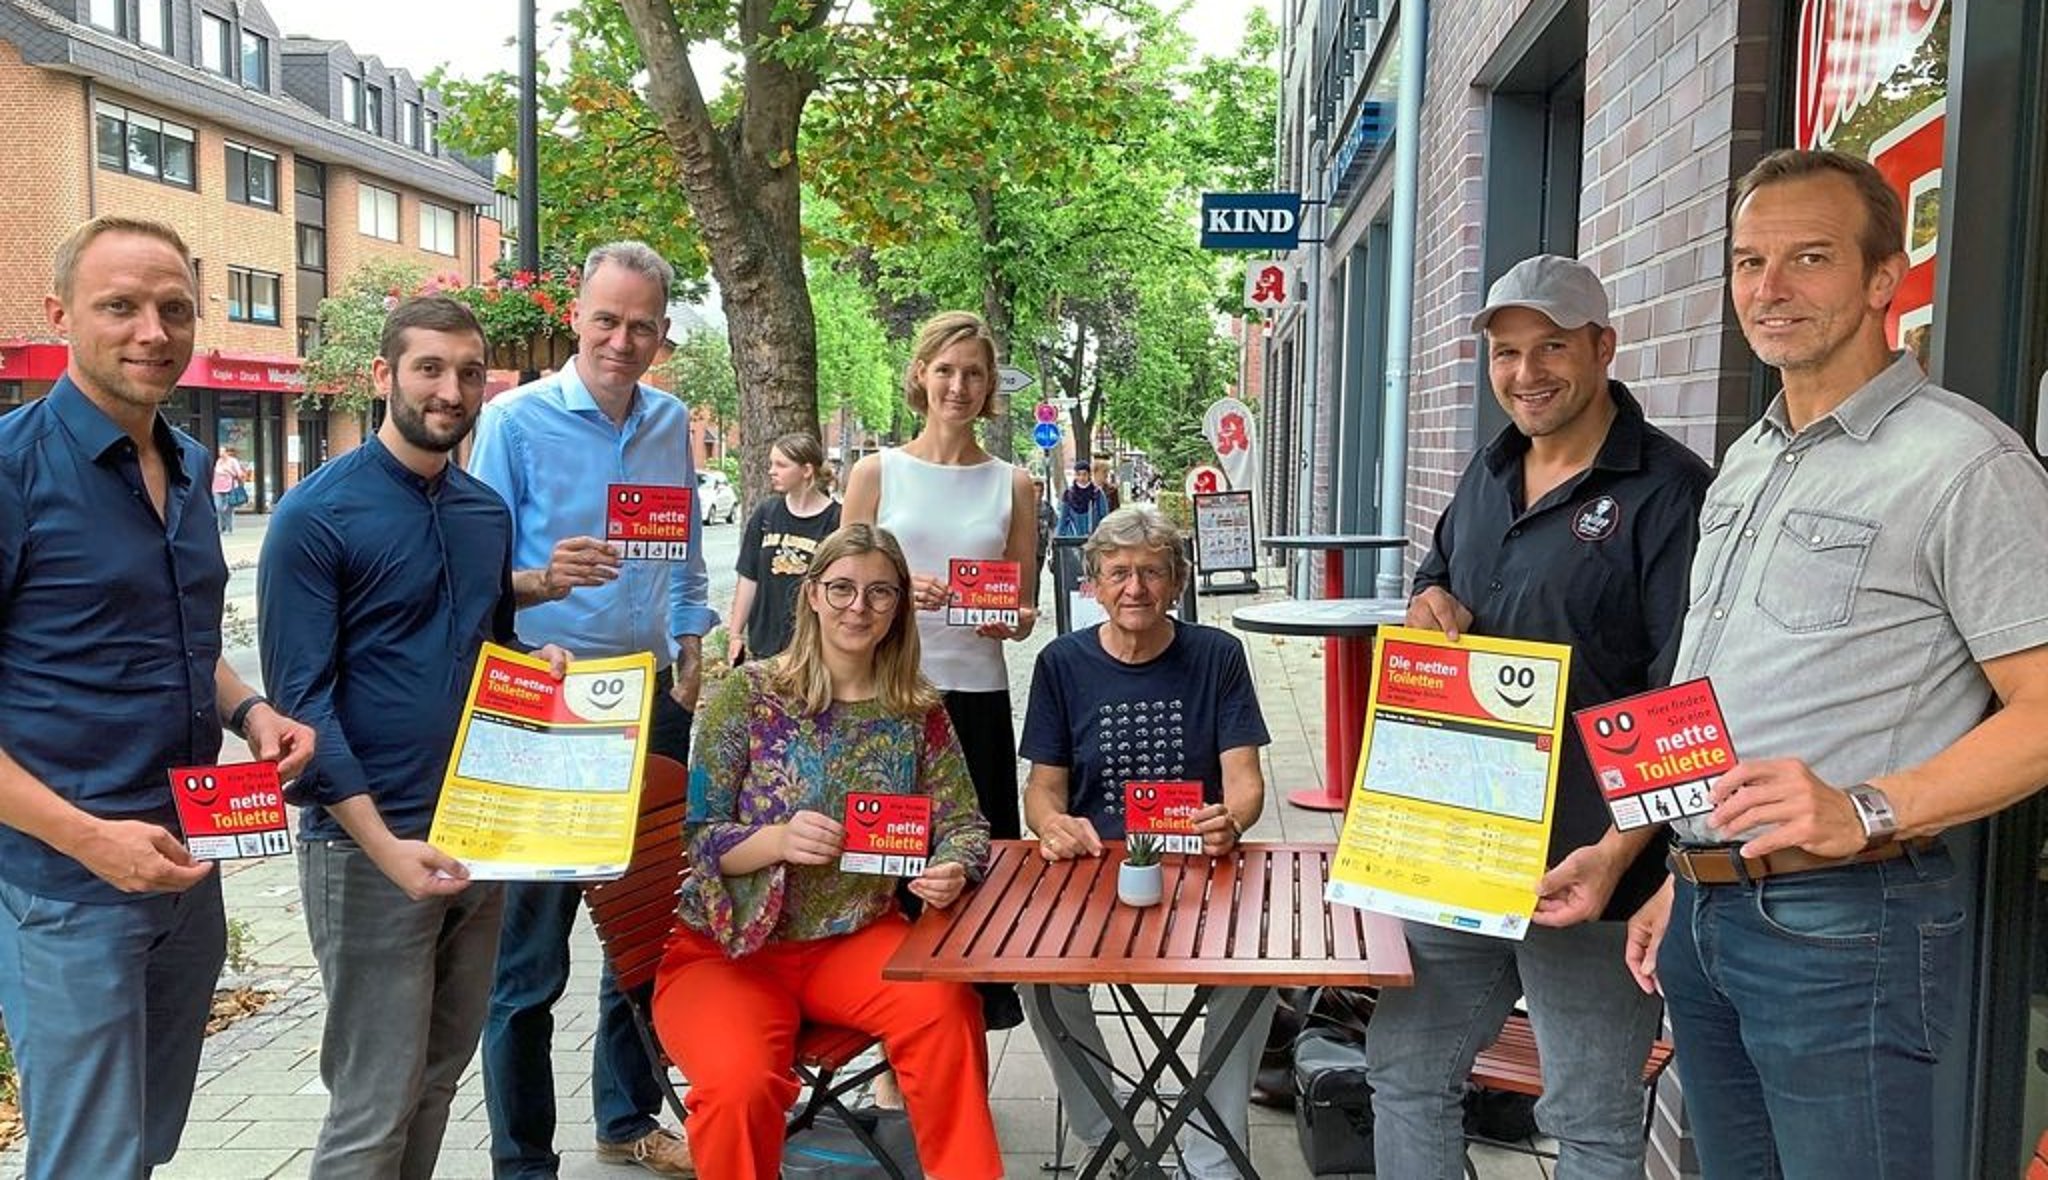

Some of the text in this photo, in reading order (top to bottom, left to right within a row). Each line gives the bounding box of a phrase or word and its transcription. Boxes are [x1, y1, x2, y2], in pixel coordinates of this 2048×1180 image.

[1208, 209, 1294, 233] KIND
[649, 511, 685, 523] nette
[631, 522, 685, 536] Toilette
[984, 583, 1017, 593] nette
[970, 593, 1016, 605] Toilette
[1388, 655, 1457, 676] Die netten
[489, 668, 554, 695] Die netten
[1387, 669, 1444, 689] Toiletten
[488, 680, 542, 702] Toiletten
[1655, 724, 1719, 753] nette
[1635, 747, 1727, 782] Toilette
[229, 792, 278, 809] nette
[211, 809, 280, 829] Toilette
[887, 822, 925, 836] nette
[868, 833, 924, 851] Toilette
